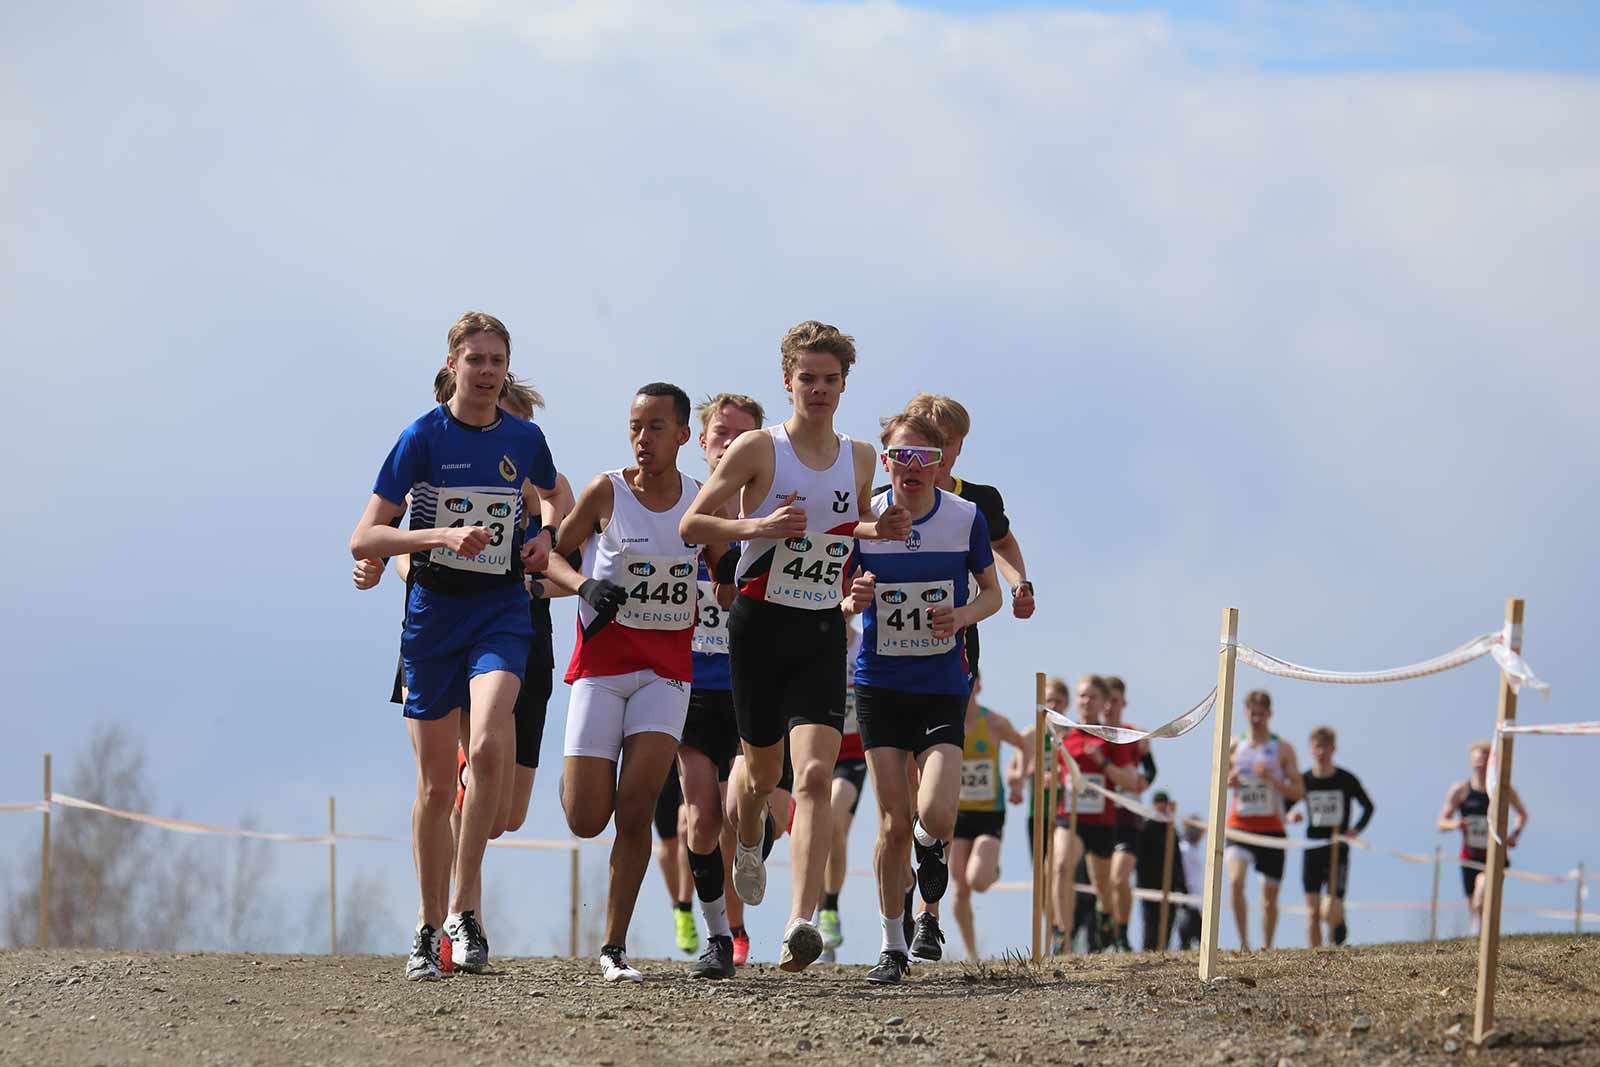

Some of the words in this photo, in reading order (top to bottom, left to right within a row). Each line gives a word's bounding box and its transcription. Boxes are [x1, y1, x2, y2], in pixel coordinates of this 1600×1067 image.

[783, 557, 842, 586] 445
[630, 581, 689, 605] 448
[773, 586, 838, 602] JENSU
